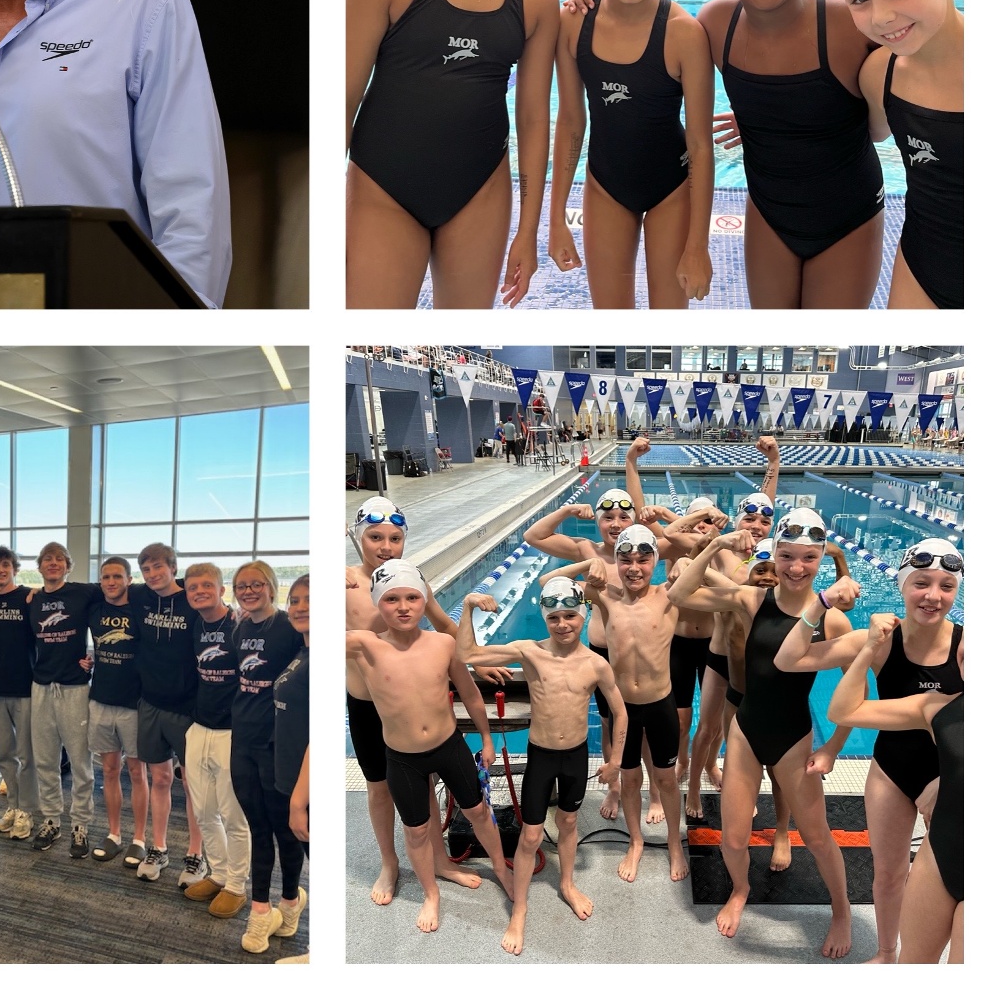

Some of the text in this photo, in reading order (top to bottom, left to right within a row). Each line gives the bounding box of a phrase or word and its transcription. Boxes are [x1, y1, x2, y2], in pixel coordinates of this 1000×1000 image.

[40, 39, 91, 52] speedo
[448, 36, 479, 50] MOR
[602, 81, 630, 93] MOR
[907, 134, 936, 153] MOR
[598, 380, 608, 396] 8
[823, 394, 833, 409] 7
[41, 601, 65, 611] MOR
[100, 616, 130, 628] MOR
[143, 617, 187, 630] SWIMMING
[200, 631, 226, 643] MOR
[240, 639, 265, 651] MOR
